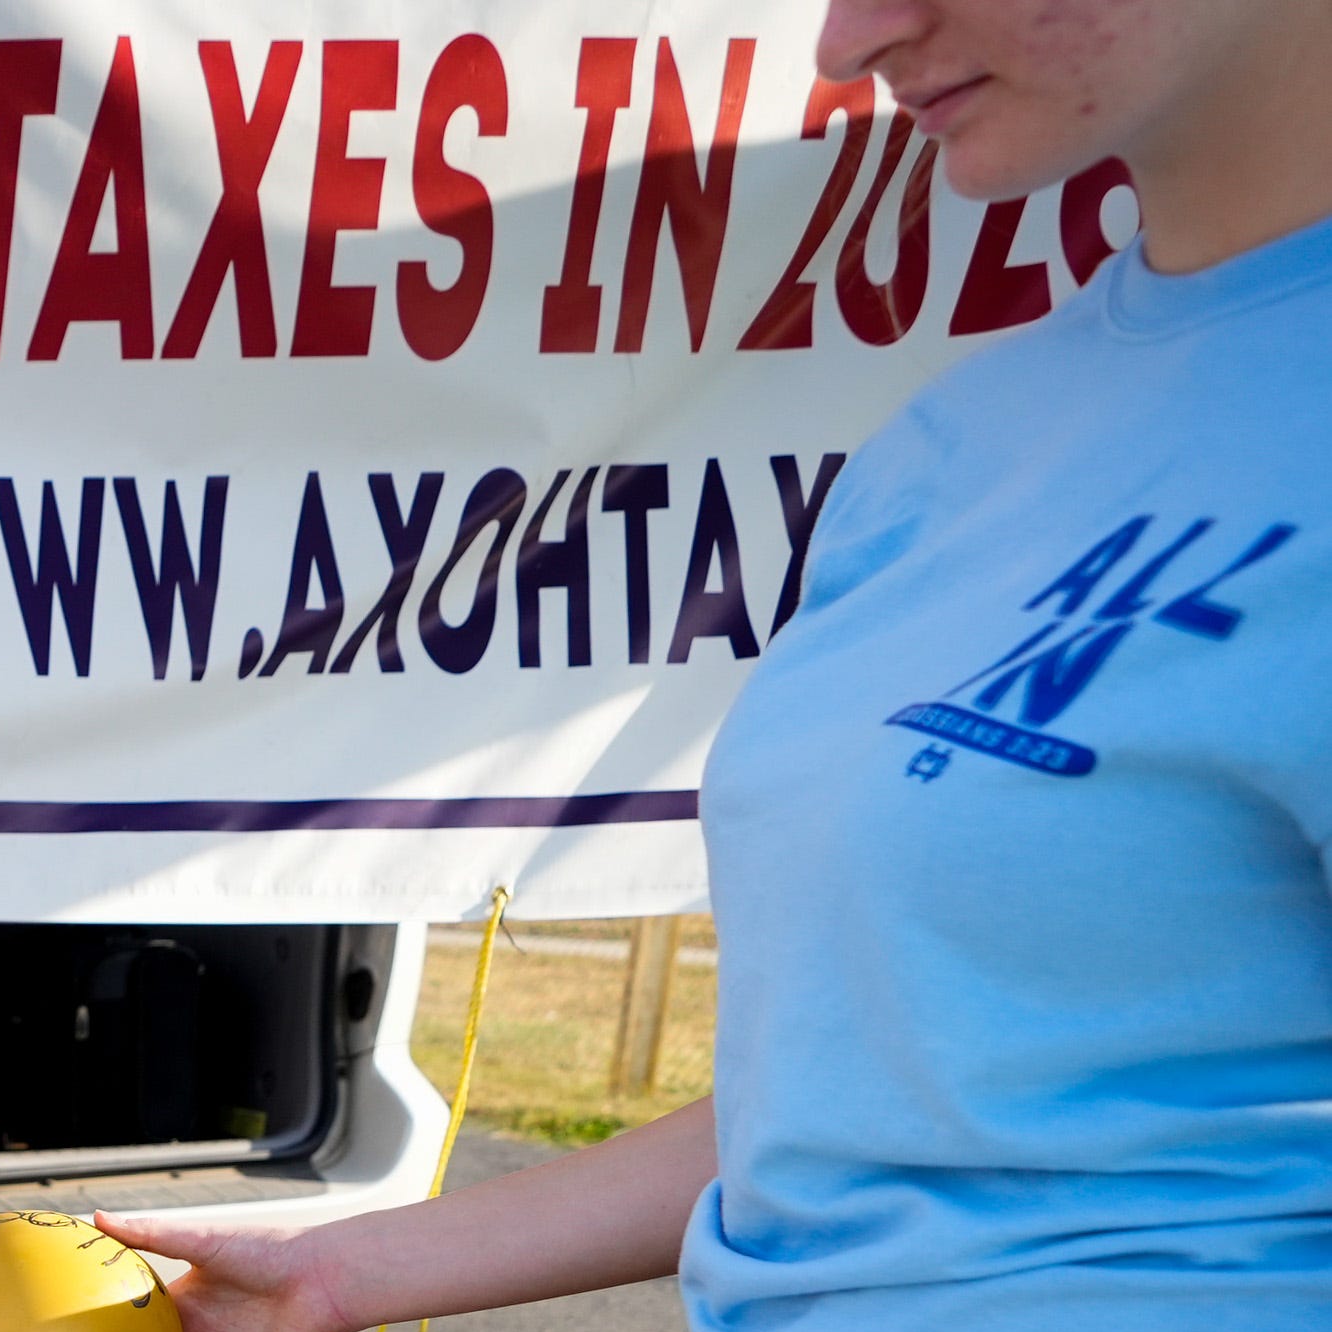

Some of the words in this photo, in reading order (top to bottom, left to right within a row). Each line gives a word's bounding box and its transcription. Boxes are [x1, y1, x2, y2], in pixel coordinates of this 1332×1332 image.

[539, 36, 757, 355] IN
[1021, 513, 1301, 642] ALL
[940, 619, 1136, 729] IN
